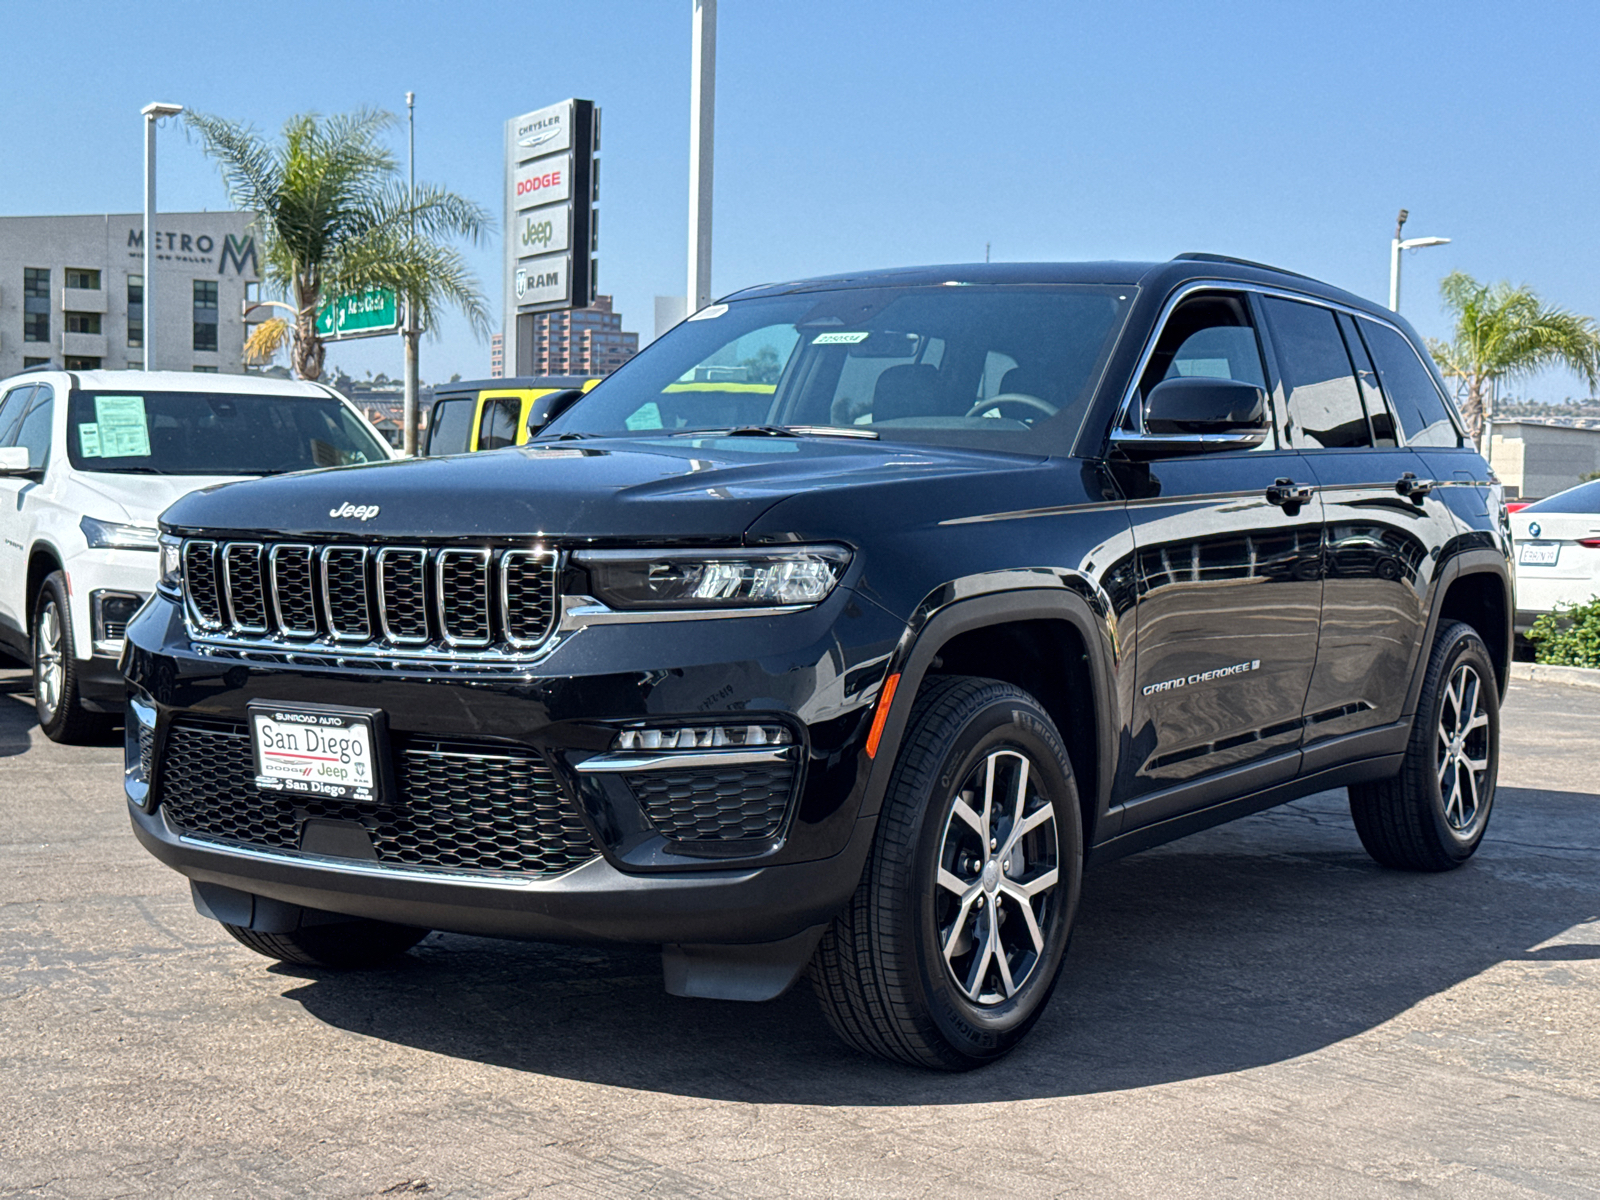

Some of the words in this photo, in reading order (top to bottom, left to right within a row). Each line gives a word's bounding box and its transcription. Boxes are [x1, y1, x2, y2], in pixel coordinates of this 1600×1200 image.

[518, 115, 560, 136] CHRYSLER
[517, 171, 561, 196] DODGE
[127, 229, 214, 253] METRO
[522, 217, 552, 248] Jeep
[527, 272, 559, 290] RAM
[329, 501, 380, 521] Jeep
[1142, 677, 1186, 696] GRAND
[1187, 662, 1251, 685] CHEROKEE
[274, 713, 318, 724] SUNROAD
[319, 716, 342, 726] AUTO
[262, 725, 299, 751] San
[304, 728, 362, 764] Diego
[1033, 720, 1070, 776] MICHELIN
[317, 762, 348, 780] Jeep
[285, 779, 308, 791] San
[311, 782, 346, 797] Diego
